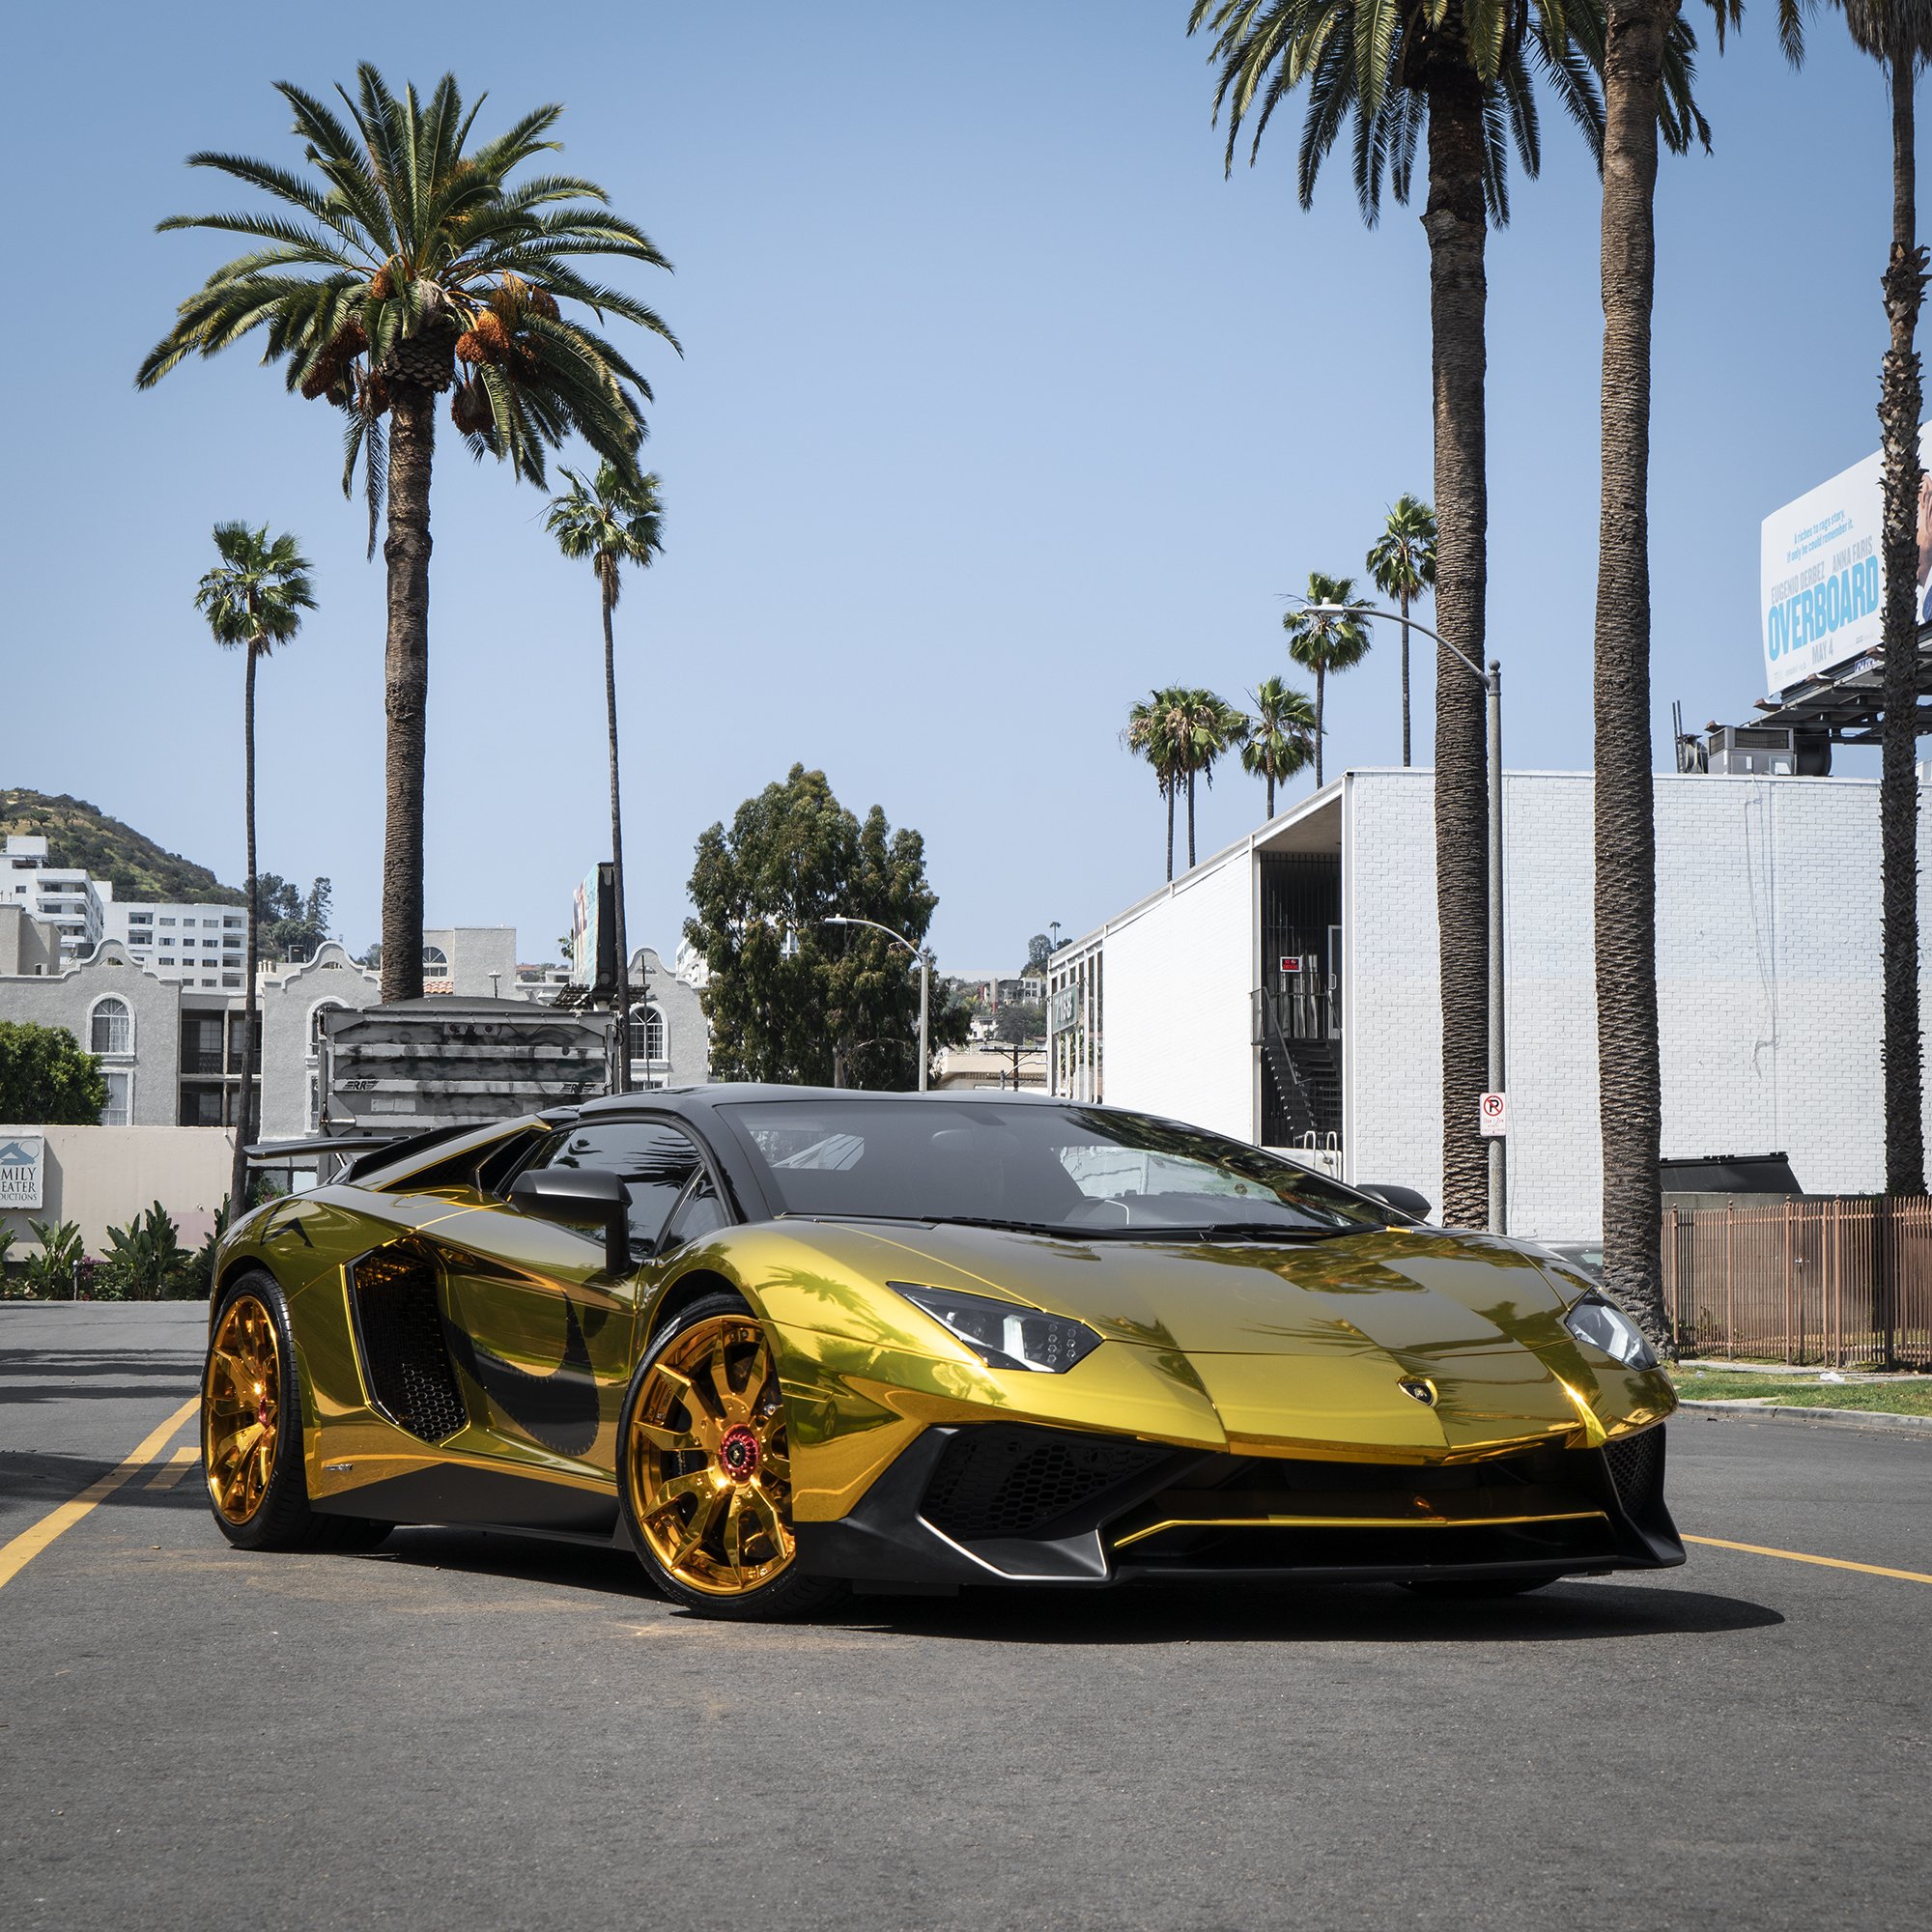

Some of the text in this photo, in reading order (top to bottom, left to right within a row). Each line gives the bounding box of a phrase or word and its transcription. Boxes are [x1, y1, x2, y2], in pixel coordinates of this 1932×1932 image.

[1792, 546, 1802, 561] only
[1802, 543, 1808, 555] he
[1808, 534, 1822, 551] could
[1823, 522, 1847, 542] remember
[1798, 527, 1812, 543] riches
[1819, 519, 1831, 531] rags
[1771, 535, 1873, 605] EUGENIO DERBEZ ANNA FARIS
[1769, 555, 1879, 661] OVERBOARD
[1811, 638, 1833, 666] MAY 4
[2, 1180, 36, 1193] EATER
